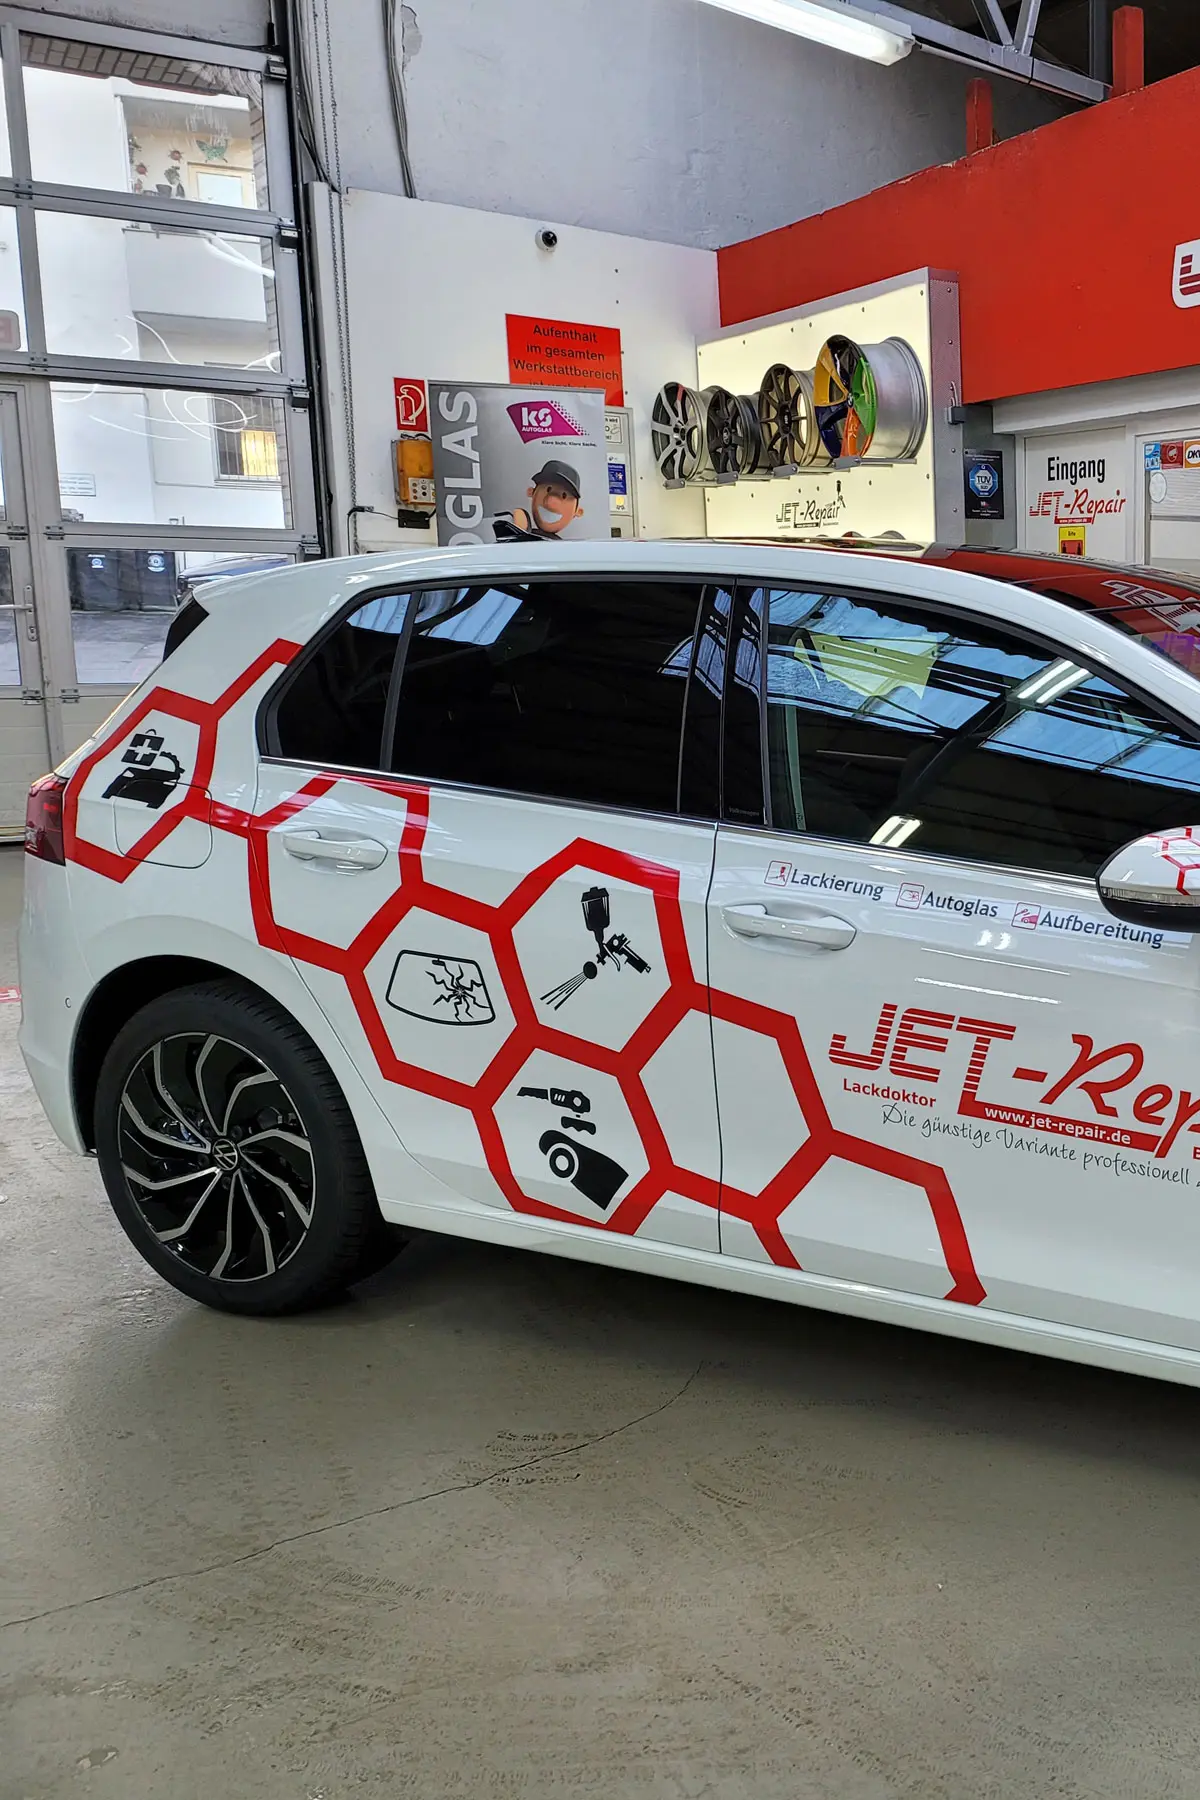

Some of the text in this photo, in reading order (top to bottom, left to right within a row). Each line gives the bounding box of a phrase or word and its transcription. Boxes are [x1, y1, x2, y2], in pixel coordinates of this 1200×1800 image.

[533, 324, 598, 343] Aufenthalt
[526, 343, 605, 361] im gesamten
[513, 359, 620, 381] Werkstattbereich
[1047, 456, 1106, 486] Eingang
[1029, 488, 1126, 525] JET-Repair
[790, 868, 884, 901] Lackierung
[922, 891, 998, 917] Autoglas
[1040, 911, 1164, 948] Aufbereitung
[843, 1078, 936, 1108] Lackdoktor
[984, 1107, 1131, 1145] www.jet-repair.de
[882, 1102, 916, 1126] Die
[922, 1117, 991, 1148] günstige
[996, 1129, 1077, 1161] Variante
[1083, 1152, 1191, 1185] professionell
